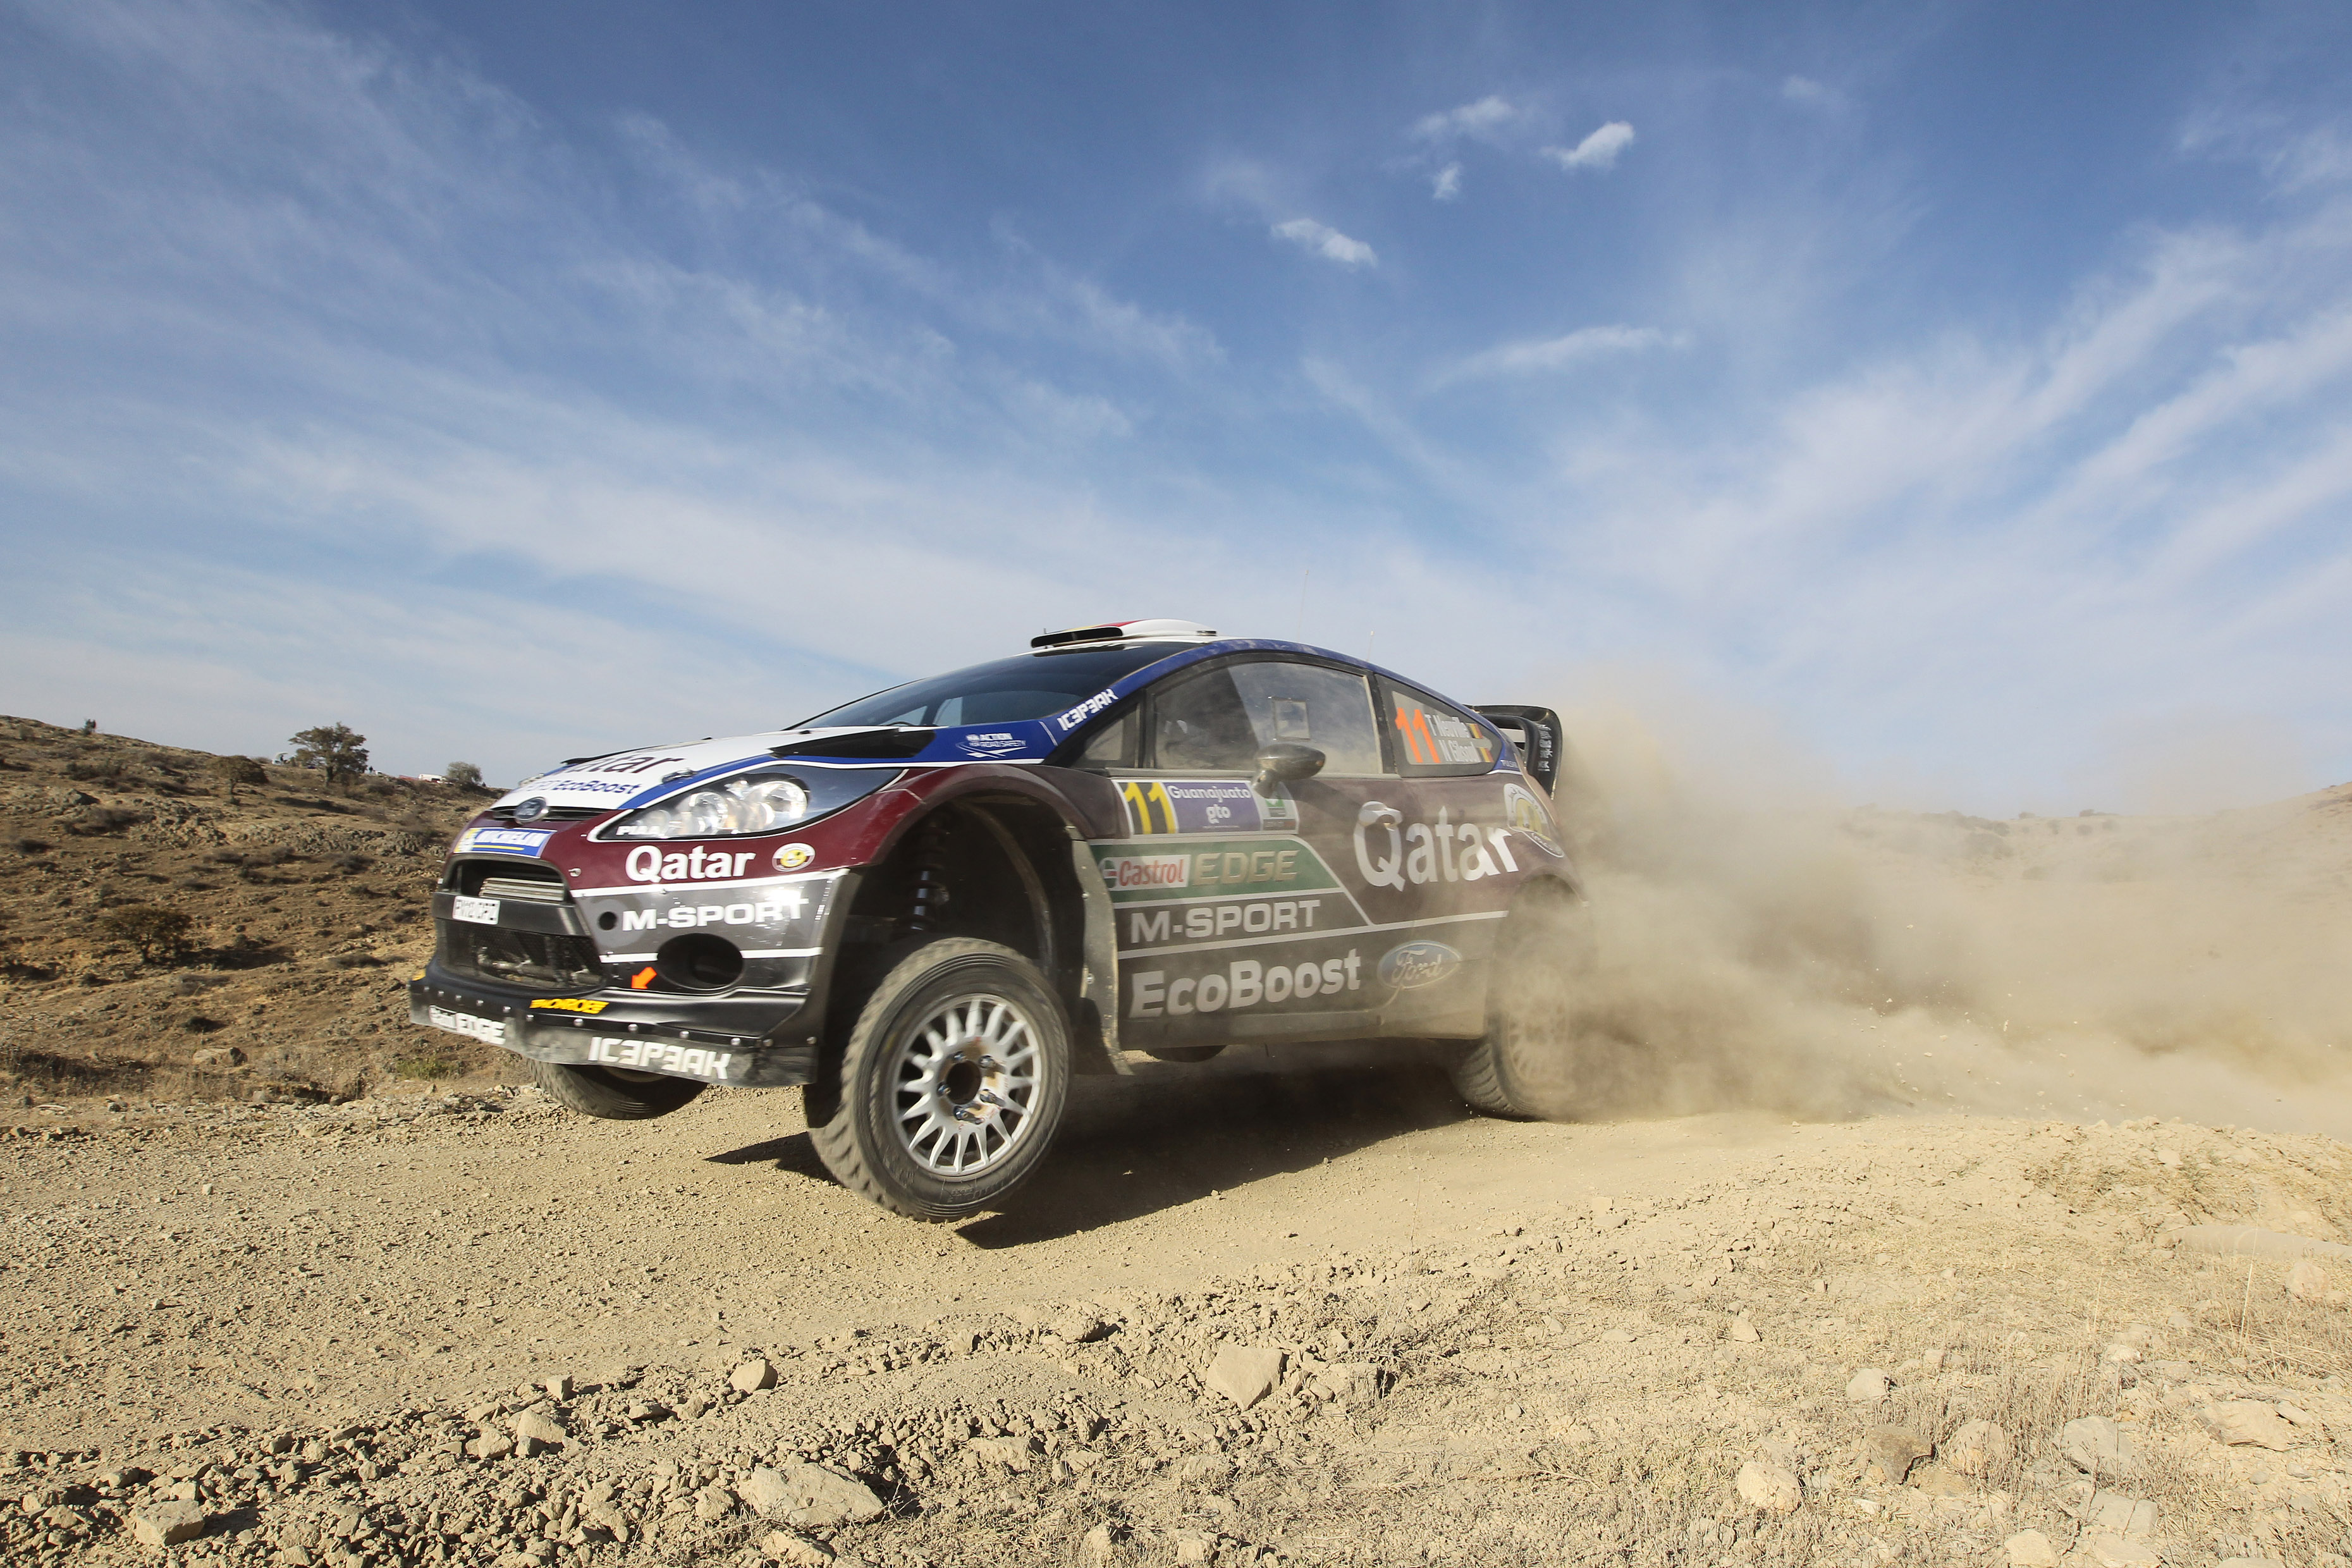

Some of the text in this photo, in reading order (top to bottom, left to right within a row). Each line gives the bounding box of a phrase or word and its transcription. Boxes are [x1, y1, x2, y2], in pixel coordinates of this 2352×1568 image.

[1395, 707, 1442, 763] 11
[1124, 782, 1177, 835] 11
[1167, 785, 1253, 803] Guanajuato
[1206, 804, 1231, 824] gto
[625, 845, 757, 883] Qatar
[1353, 801, 1519, 892] Qatar
[1118, 850, 1300, 886] Castrol EDGE
[622, 898, 809, 931] M-SPORT
[1130, 900, 1321, 944] M-SPORT
[1129, 949, 1361, 1019] EcoBoost
[1392, 949, 1442, 983] Ford
[456, 1012, 506, 1044] EDGE
